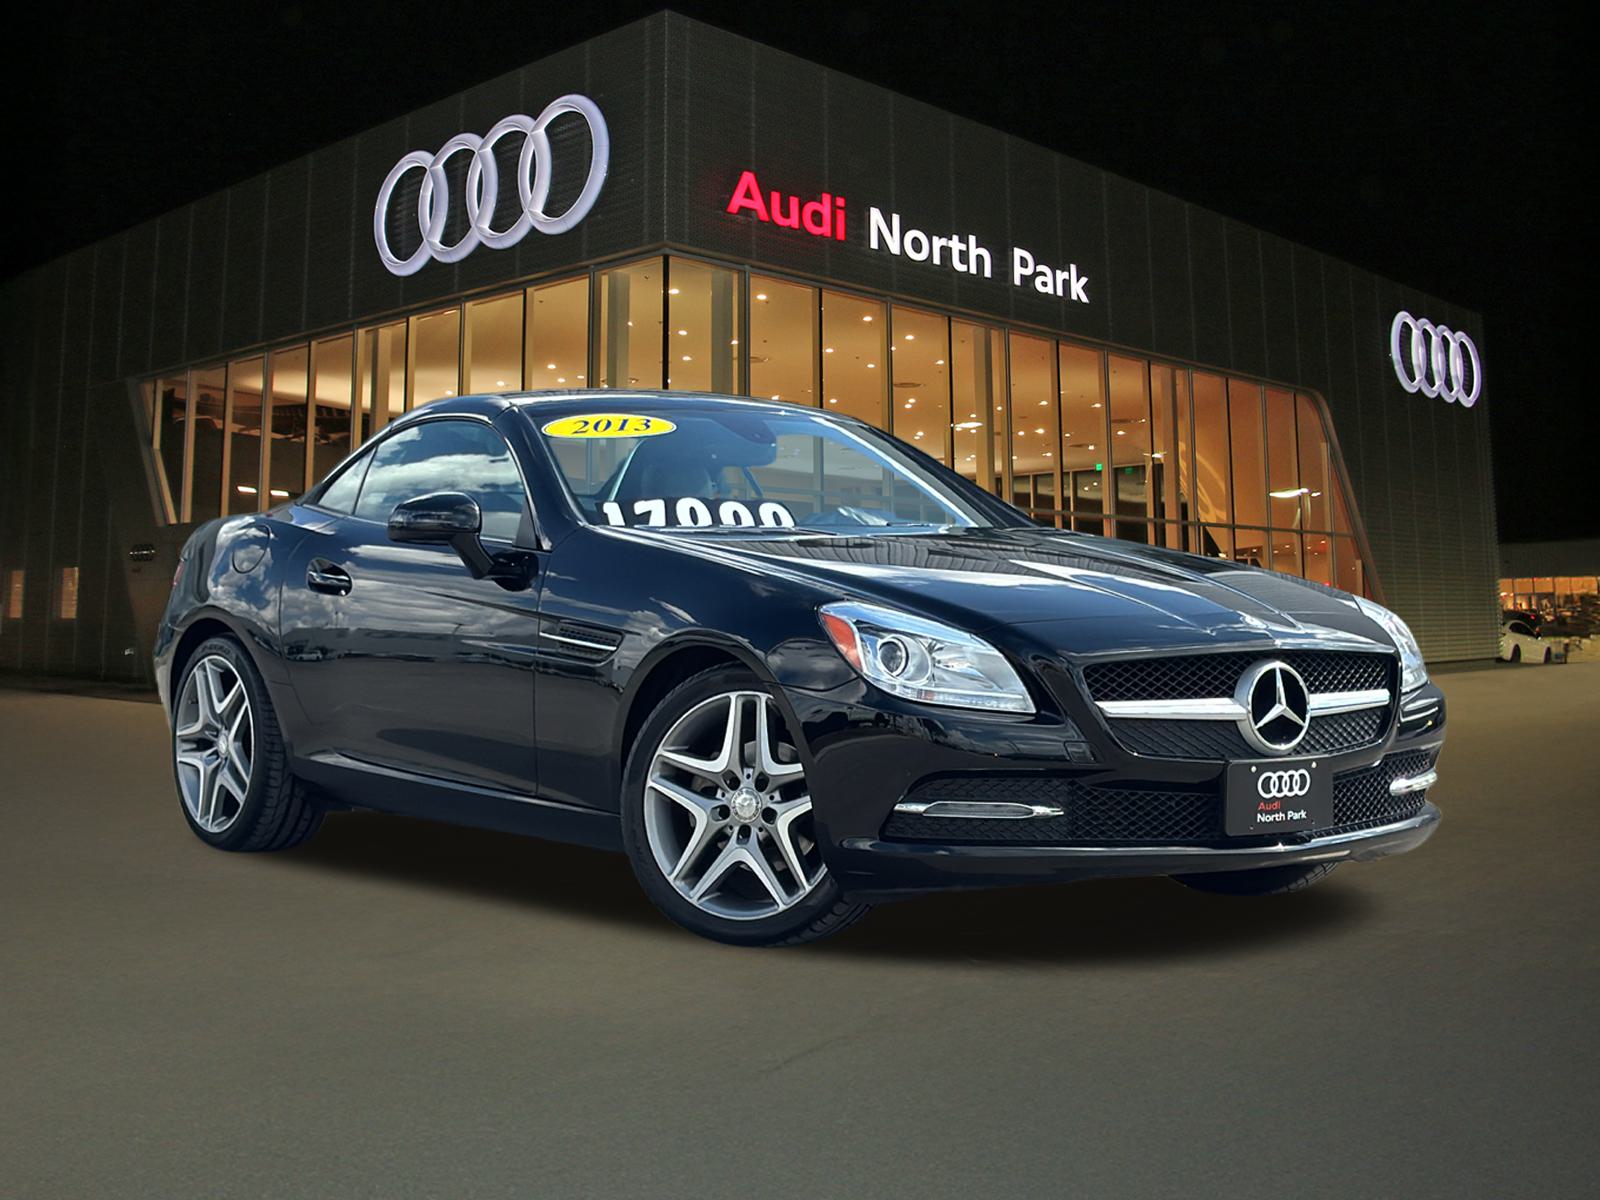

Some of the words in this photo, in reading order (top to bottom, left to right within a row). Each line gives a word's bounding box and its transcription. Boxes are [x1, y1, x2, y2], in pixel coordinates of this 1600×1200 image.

[726, 171, 846, 241] Audi
[869, 207, 992, 278] North
[1013, 247, 1090, 304] Park
[572, 418, 651, 435] 2013
[1258, 801, 1281, 811] Audi
[1256, 811, 1286, 823] North
[1287, 809, 1307, 821] Park
